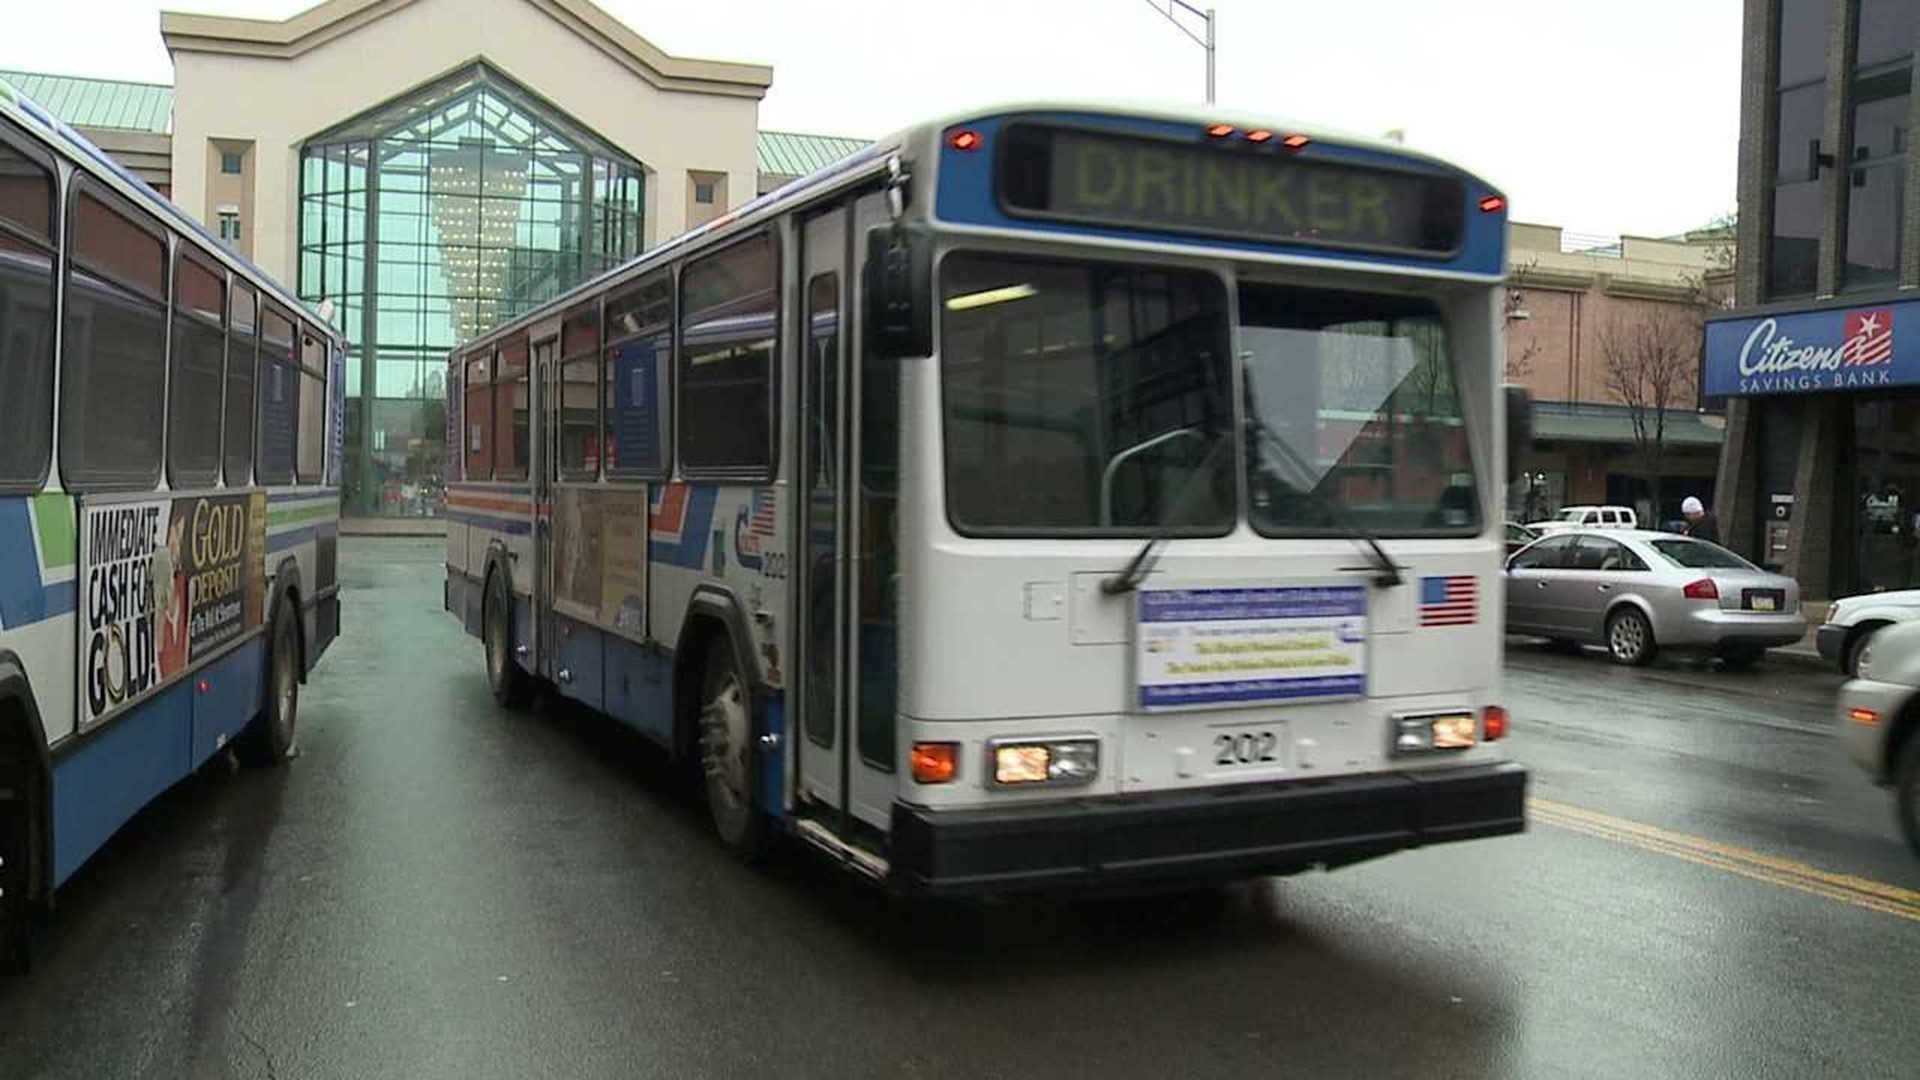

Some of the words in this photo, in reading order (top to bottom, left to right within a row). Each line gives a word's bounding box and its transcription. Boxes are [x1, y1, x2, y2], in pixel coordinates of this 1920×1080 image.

[1078, 144, 1391, 236] DRINKER
[1739, 318, 1843, 376] Citizens
[1739, 374, 1822, 394] SAVINGS
[1833, 370, 1891, 387] BANK
[90, 507, 158, 566] IMMEDIATE
[191, 498, 244, 568] GOLD
[89, 561, 129, 632] CASH
[131, 556, 156, 617] FOR
[191, 562, 241, 606] DEPOSIT
[88, 613, 156, 717] GOLD!
[1213, 731, 1278, 765] 202
